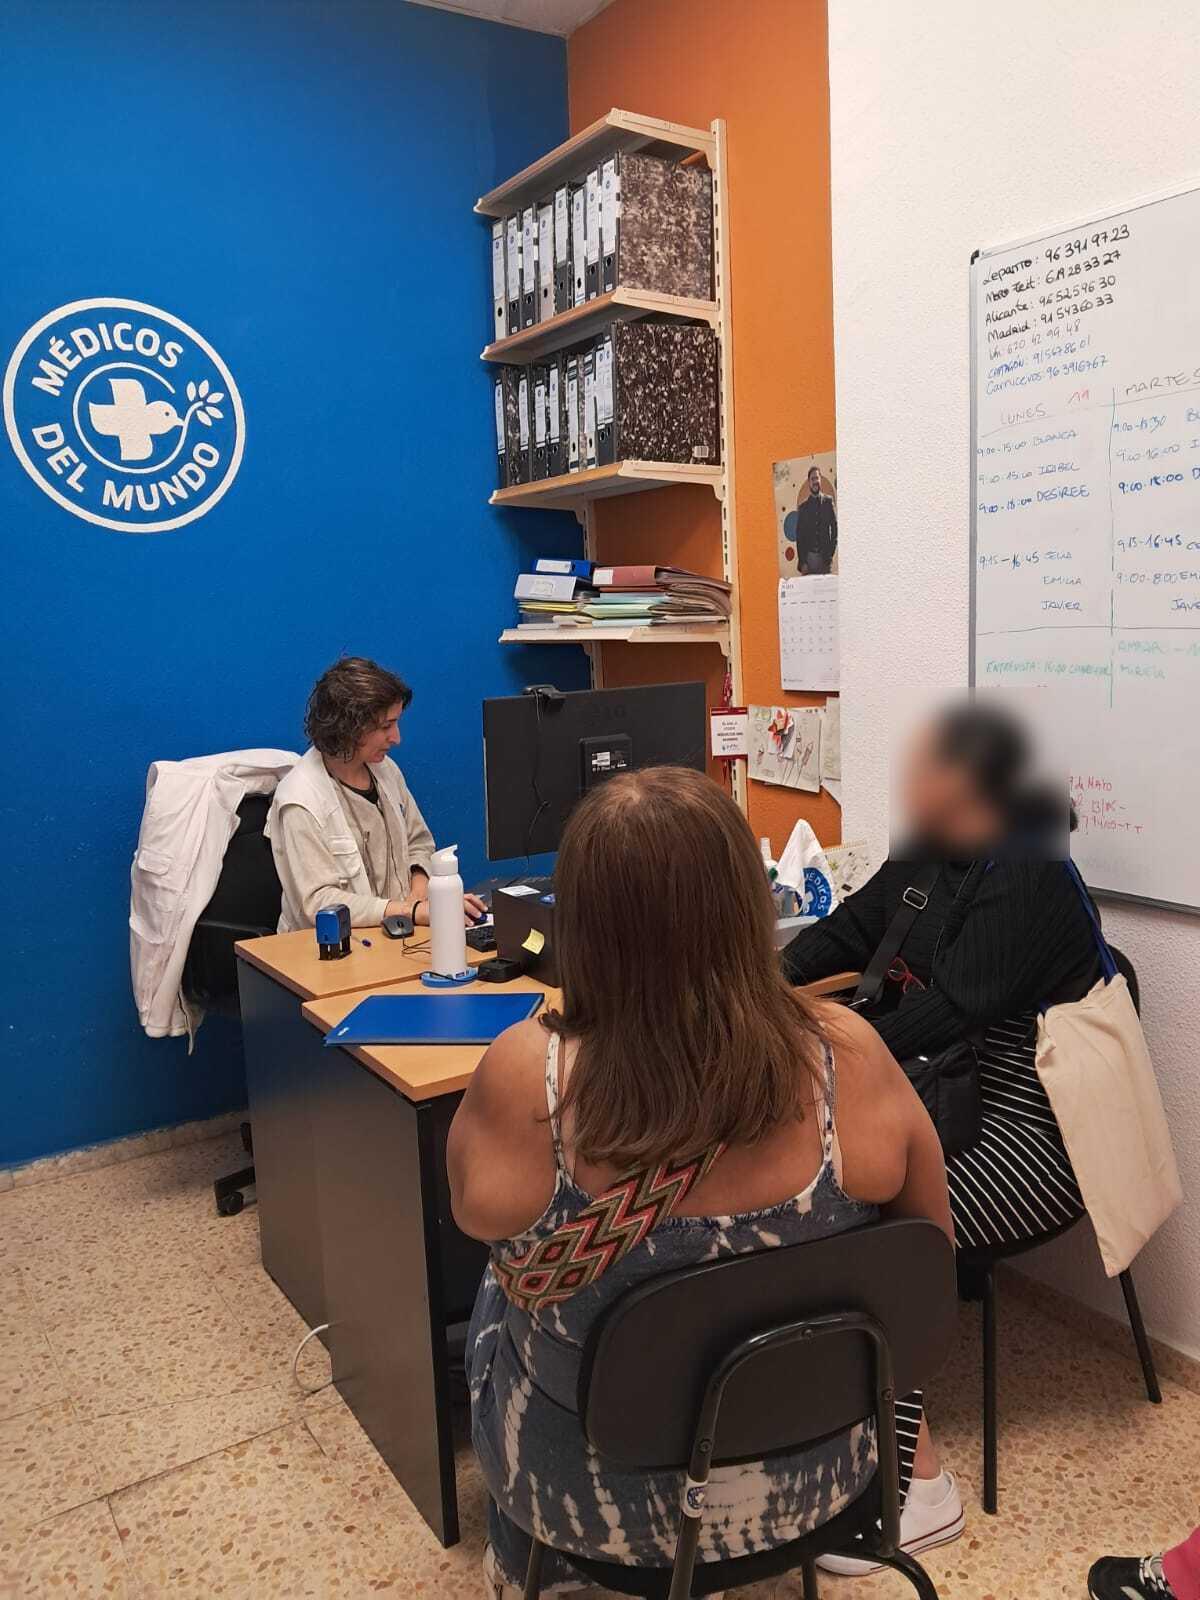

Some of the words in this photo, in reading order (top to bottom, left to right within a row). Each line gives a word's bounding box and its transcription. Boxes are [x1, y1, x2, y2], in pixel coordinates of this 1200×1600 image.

[31, 322, 184, 397] MÉDICOS
[31, 423, 88, 493] DEL
[102, 442, 220, 512] MUNDO
